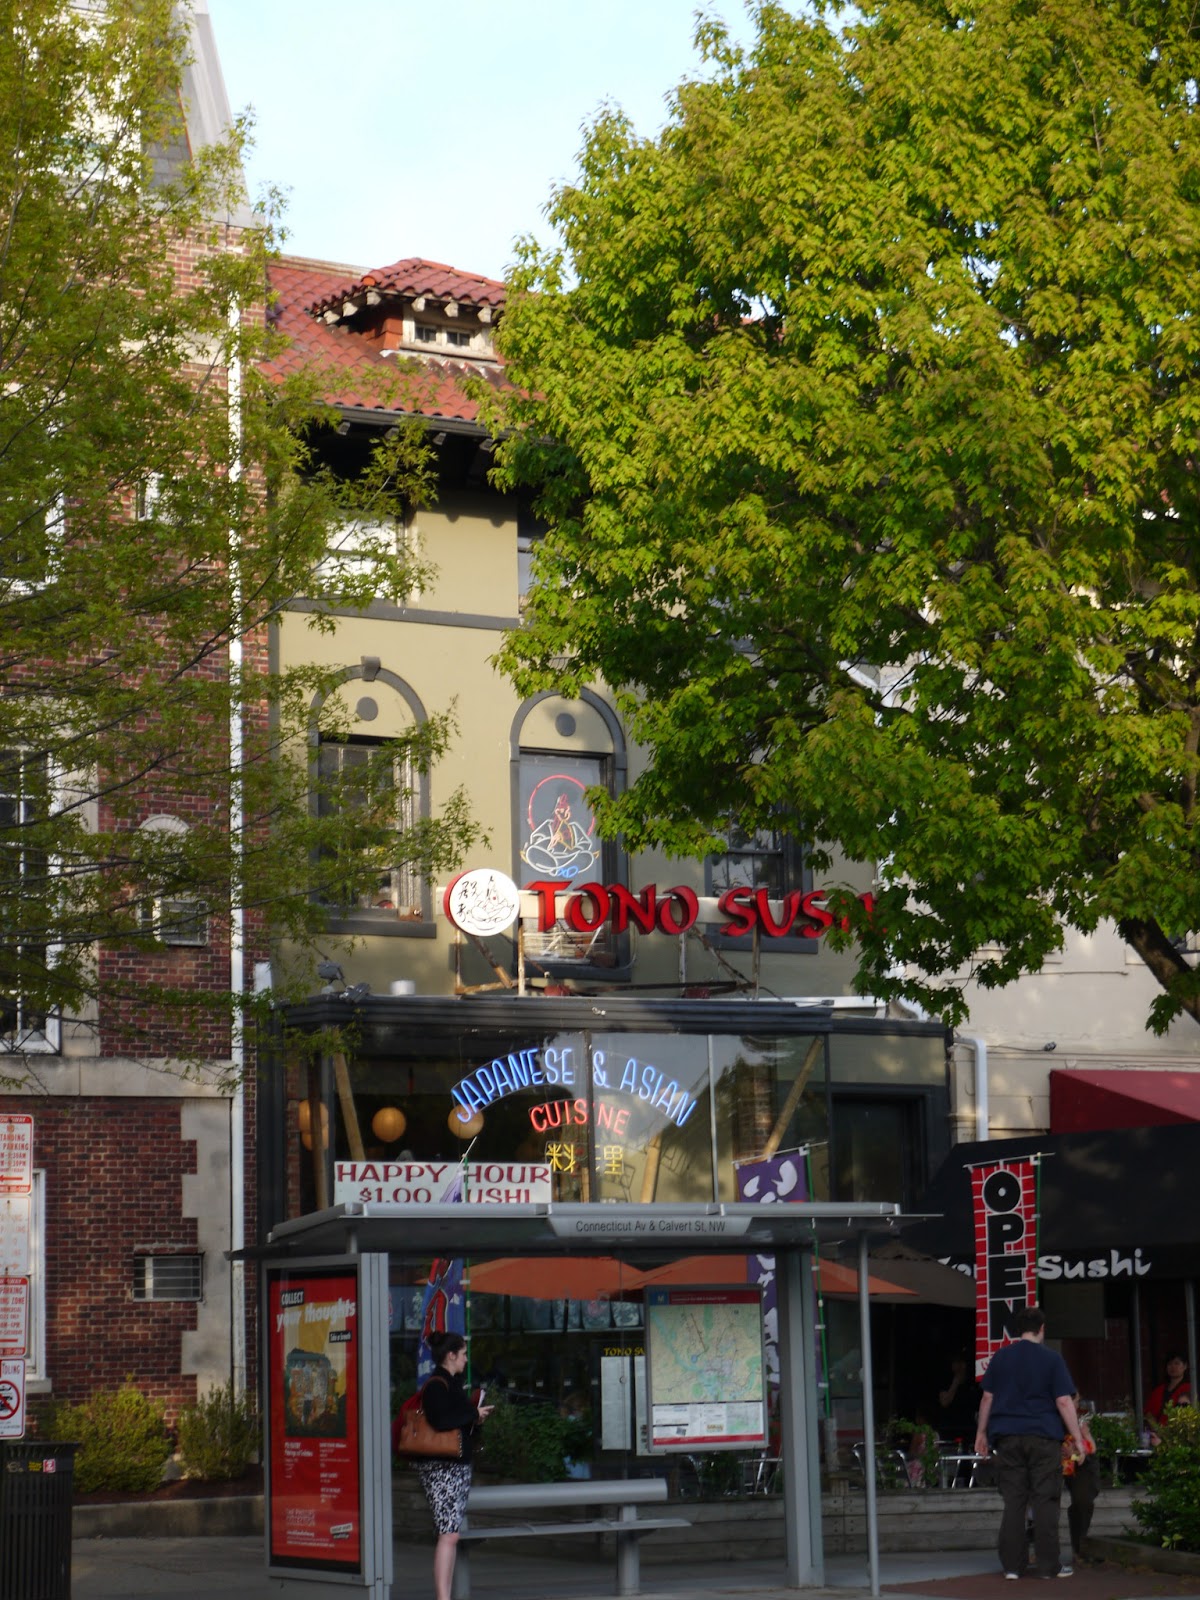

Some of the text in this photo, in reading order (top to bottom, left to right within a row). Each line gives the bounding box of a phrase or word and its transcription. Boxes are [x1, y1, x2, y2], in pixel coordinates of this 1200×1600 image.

[524, 880, 888, 940] TONO SUS
[451, 1048, 698, 1128] JAPANESE & ASIAN
[530, 1098, 630, 1135] CUISNE
[3, 1143, 29, 1151] PARKING
[336, 1163, 551, 1184] HAPPY HOUR
[359, 1187, 531, 1203] $1.00 USHI
[575, 1220, 631, 1232] Connecticut
[634, 1221, 646, 1232] Av
[649, 1221, 656, 1232] &
[658, 1221, 692, 1232] Calvert
[708, 1221, 725, 1231] NW
[982, 1169, 1028, 1342] OPEN
[1037, 1247, 1152, 1280] Sushi
[281, 1291, 304, 1305] COLLECT
[304, 1297, 356, 1325] thoughts
